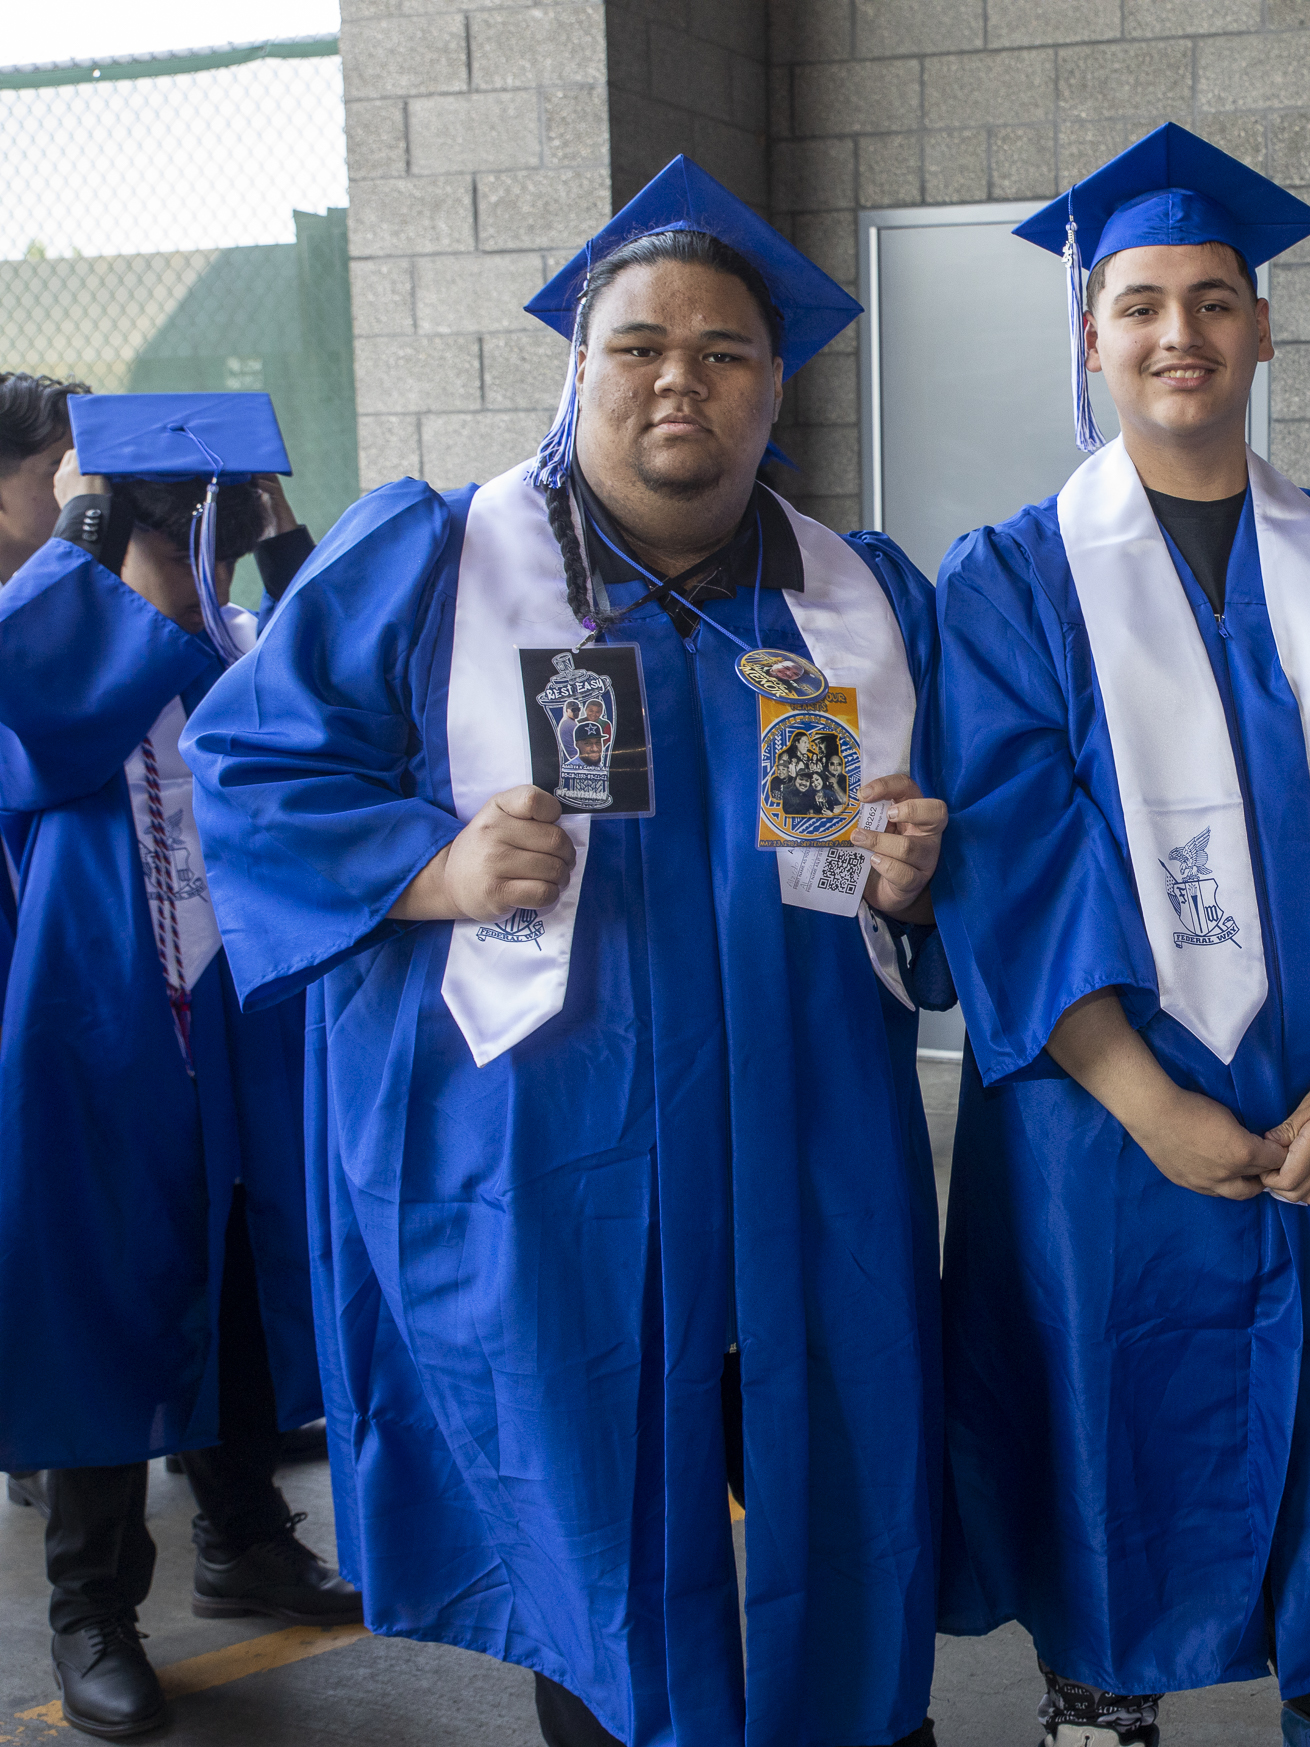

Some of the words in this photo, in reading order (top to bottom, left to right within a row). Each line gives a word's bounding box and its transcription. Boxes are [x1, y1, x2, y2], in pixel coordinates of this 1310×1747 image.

[546, 685, 572, 700] REST
[576, 678, 605, 692] EASY
[480, 928, 522, 942] FEDERAL
[524, 927, 543, 940] WAY
[1176, 934, 1214, 943] FEDERAL
[1216, 925, 1237, 941] WAY
